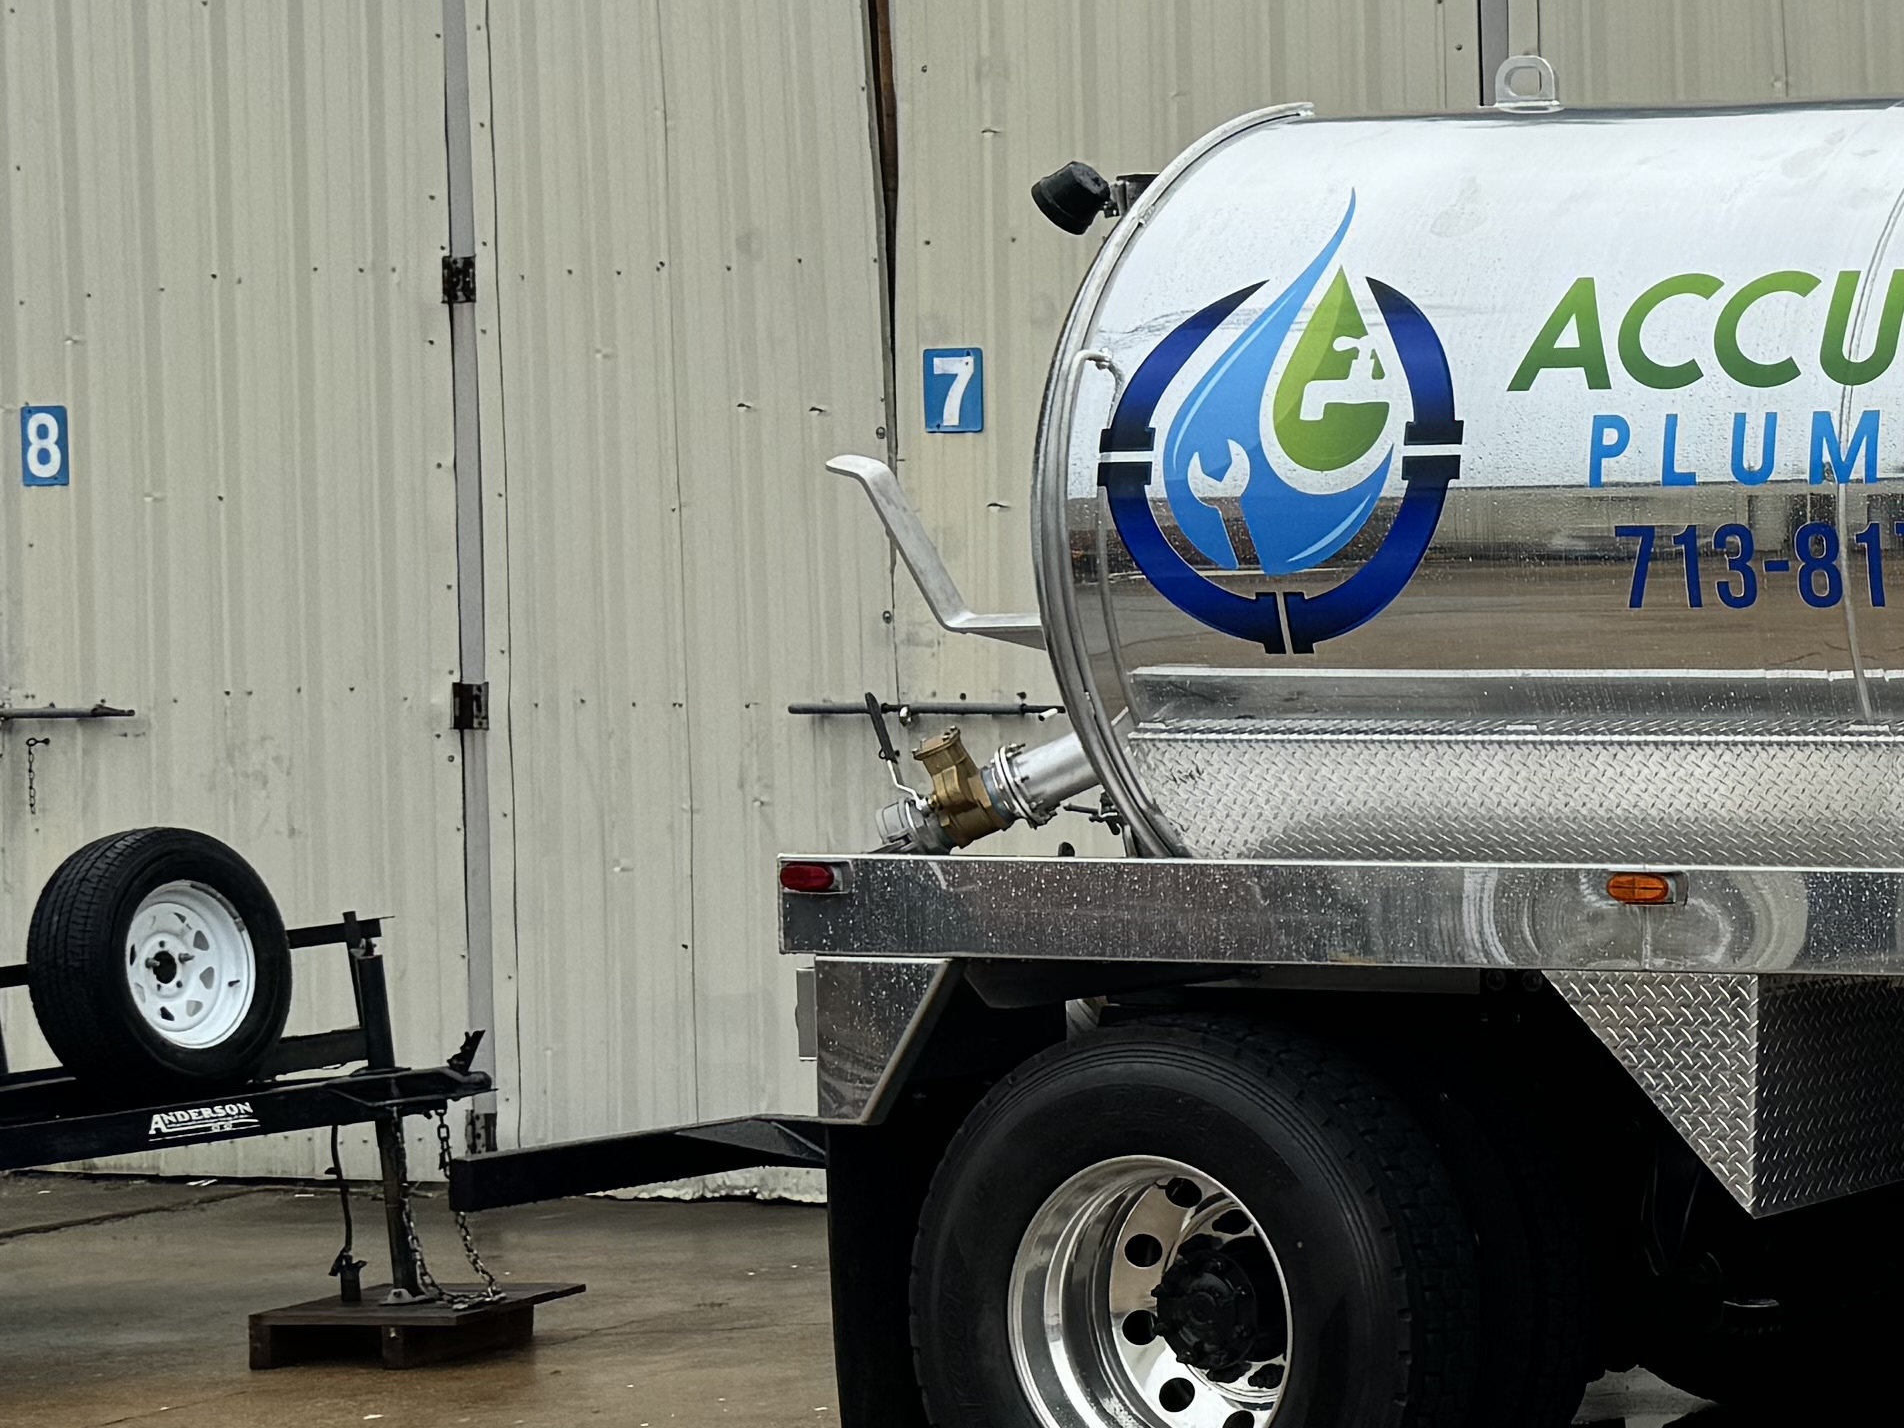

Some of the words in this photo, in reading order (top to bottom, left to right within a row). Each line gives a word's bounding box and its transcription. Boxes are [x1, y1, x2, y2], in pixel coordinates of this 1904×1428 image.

[933, 355, 975, 426] 7
[27, 412, 61, 478] 8
[148, 1101, 254, 1135] ANDERSON
